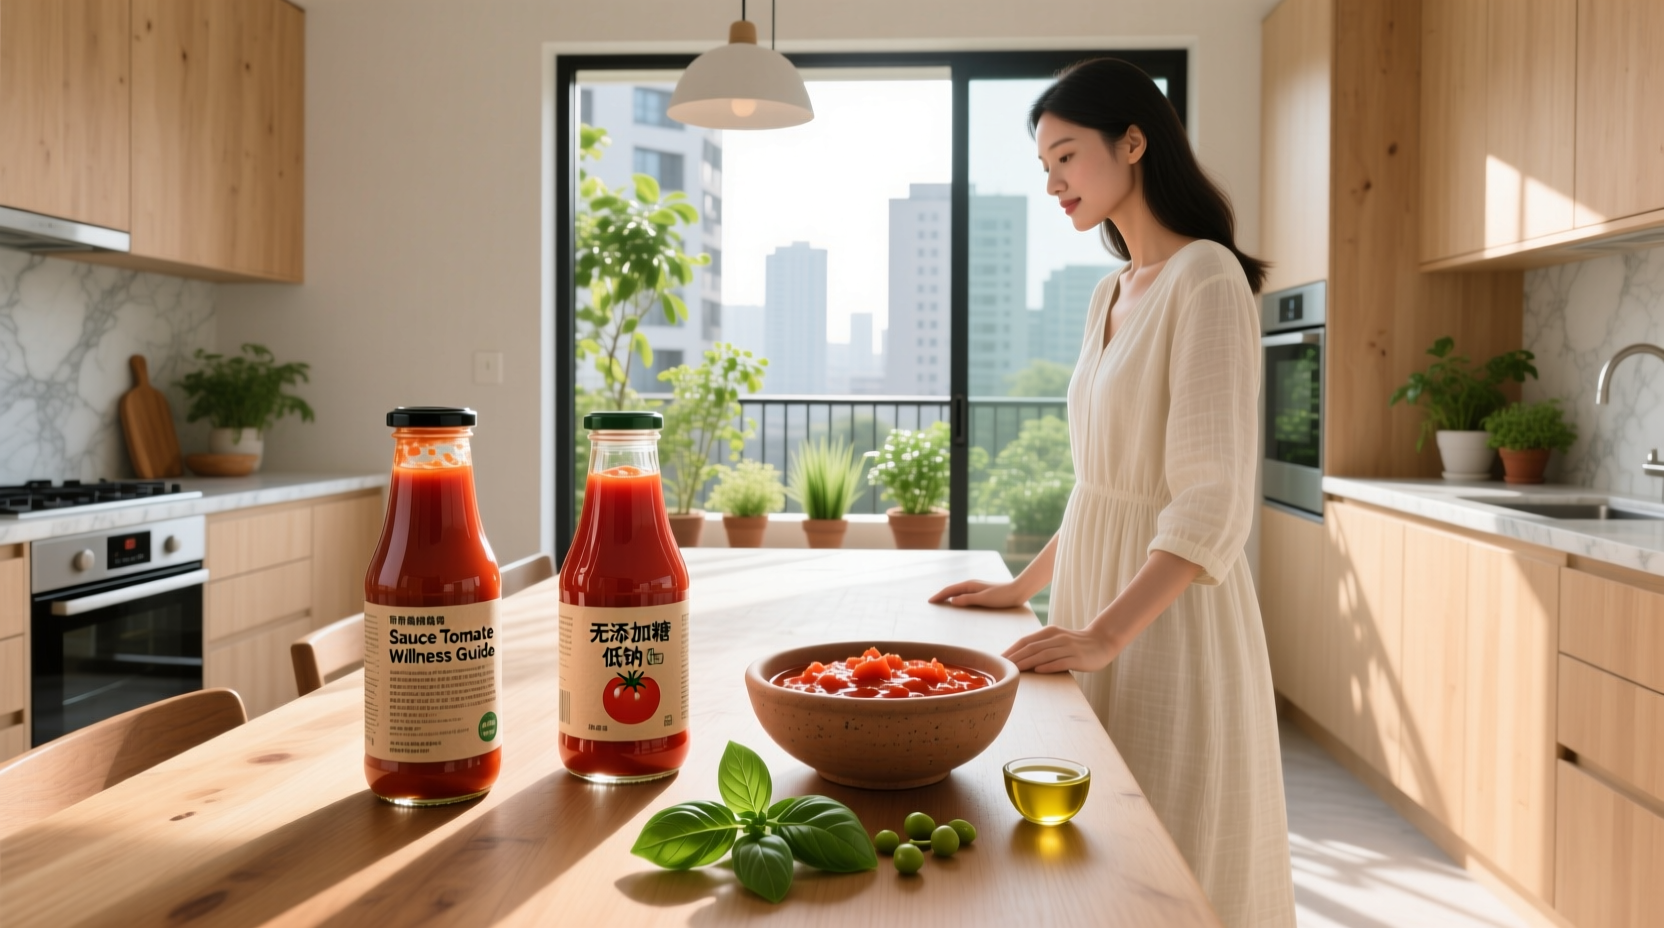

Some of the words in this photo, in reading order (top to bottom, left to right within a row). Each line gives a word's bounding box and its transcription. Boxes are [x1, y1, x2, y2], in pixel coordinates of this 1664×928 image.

[389, 629, 437, 645] Sauce
[439, 626, 494, 644] Tomate
[590, 620, 671, 643] 无添加糖
[389, 648, 452, 664] Willness
[456, 642, 495, 661] Guide
[602, 646, 643, 668] 低钠
